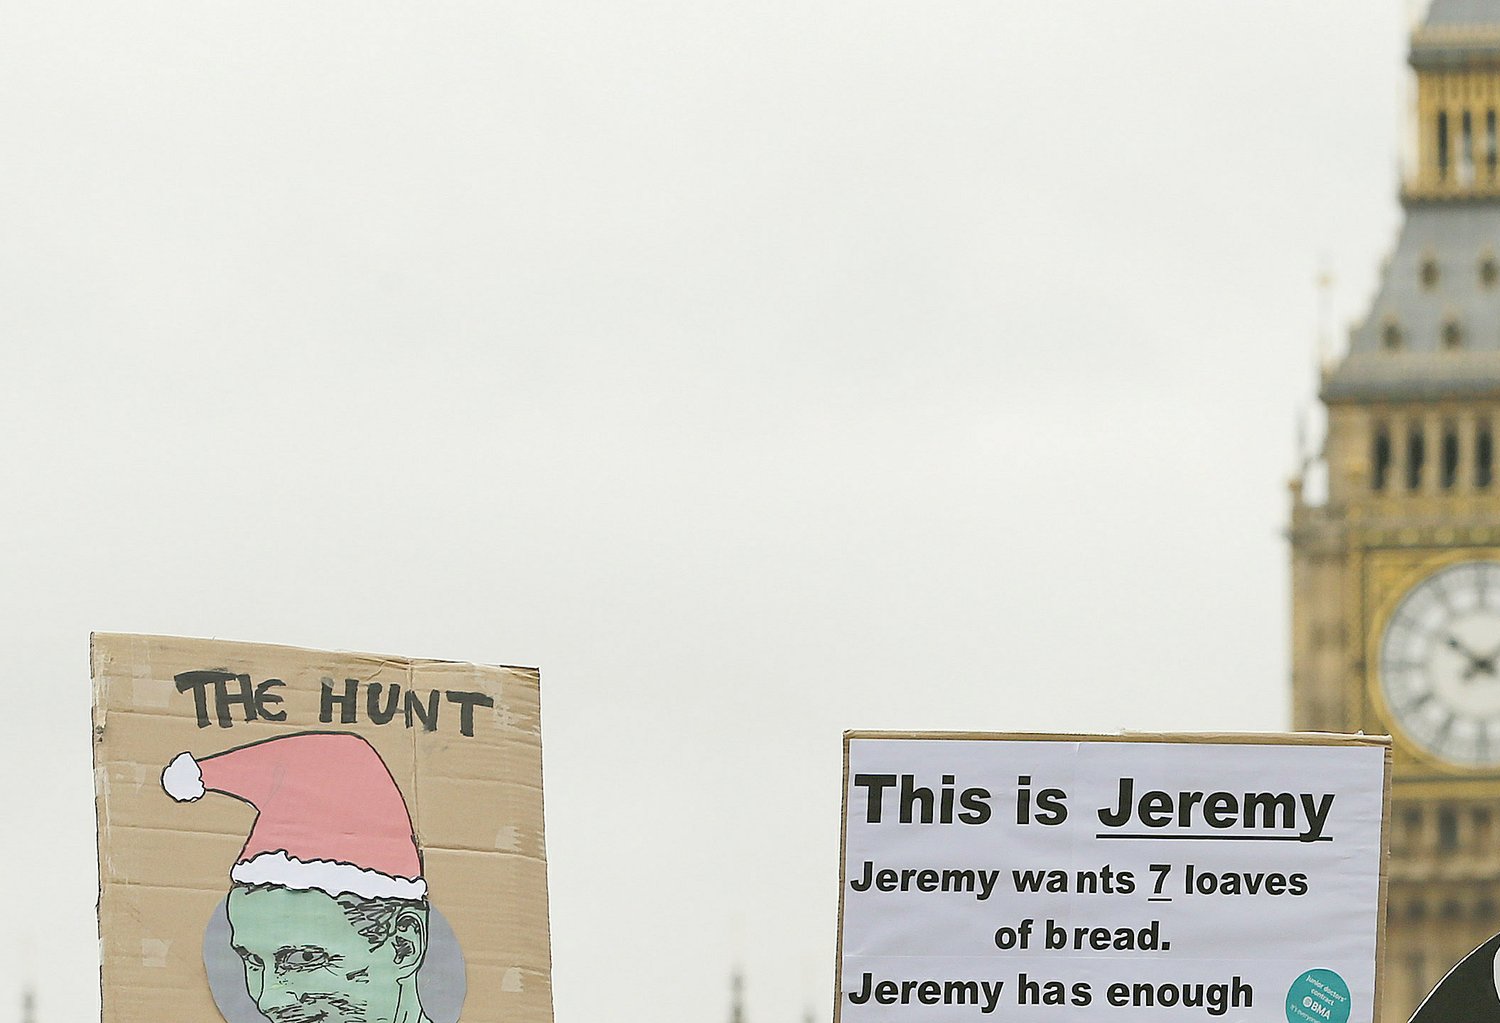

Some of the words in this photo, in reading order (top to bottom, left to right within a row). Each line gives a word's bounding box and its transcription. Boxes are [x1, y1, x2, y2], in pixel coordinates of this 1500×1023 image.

[174, 669, 287, 728] THE
[319, 677, 494, 738] HUNT
[854, 773, 992, 825] This
[1016, 775, 1068, 826] is
[1097, 777, 1335, 842] Jeremy
[850, 861, 1000, 901] Jeremy
[1011, 863, 1136, 895] wants
[1149, 863, 1172, 894] 7
[1185, 864, 1309, 896] loaves
[994, 918, 1034, 950] of
[1045, 919, 1171, 951] bread.
[848, 972, 1004, 1014] Jeremy
[1018, 973, 1092, 1007] has
[1106, 976, 1254, 1016] enough
[1310, 1001, 1331, 1020] BMA
